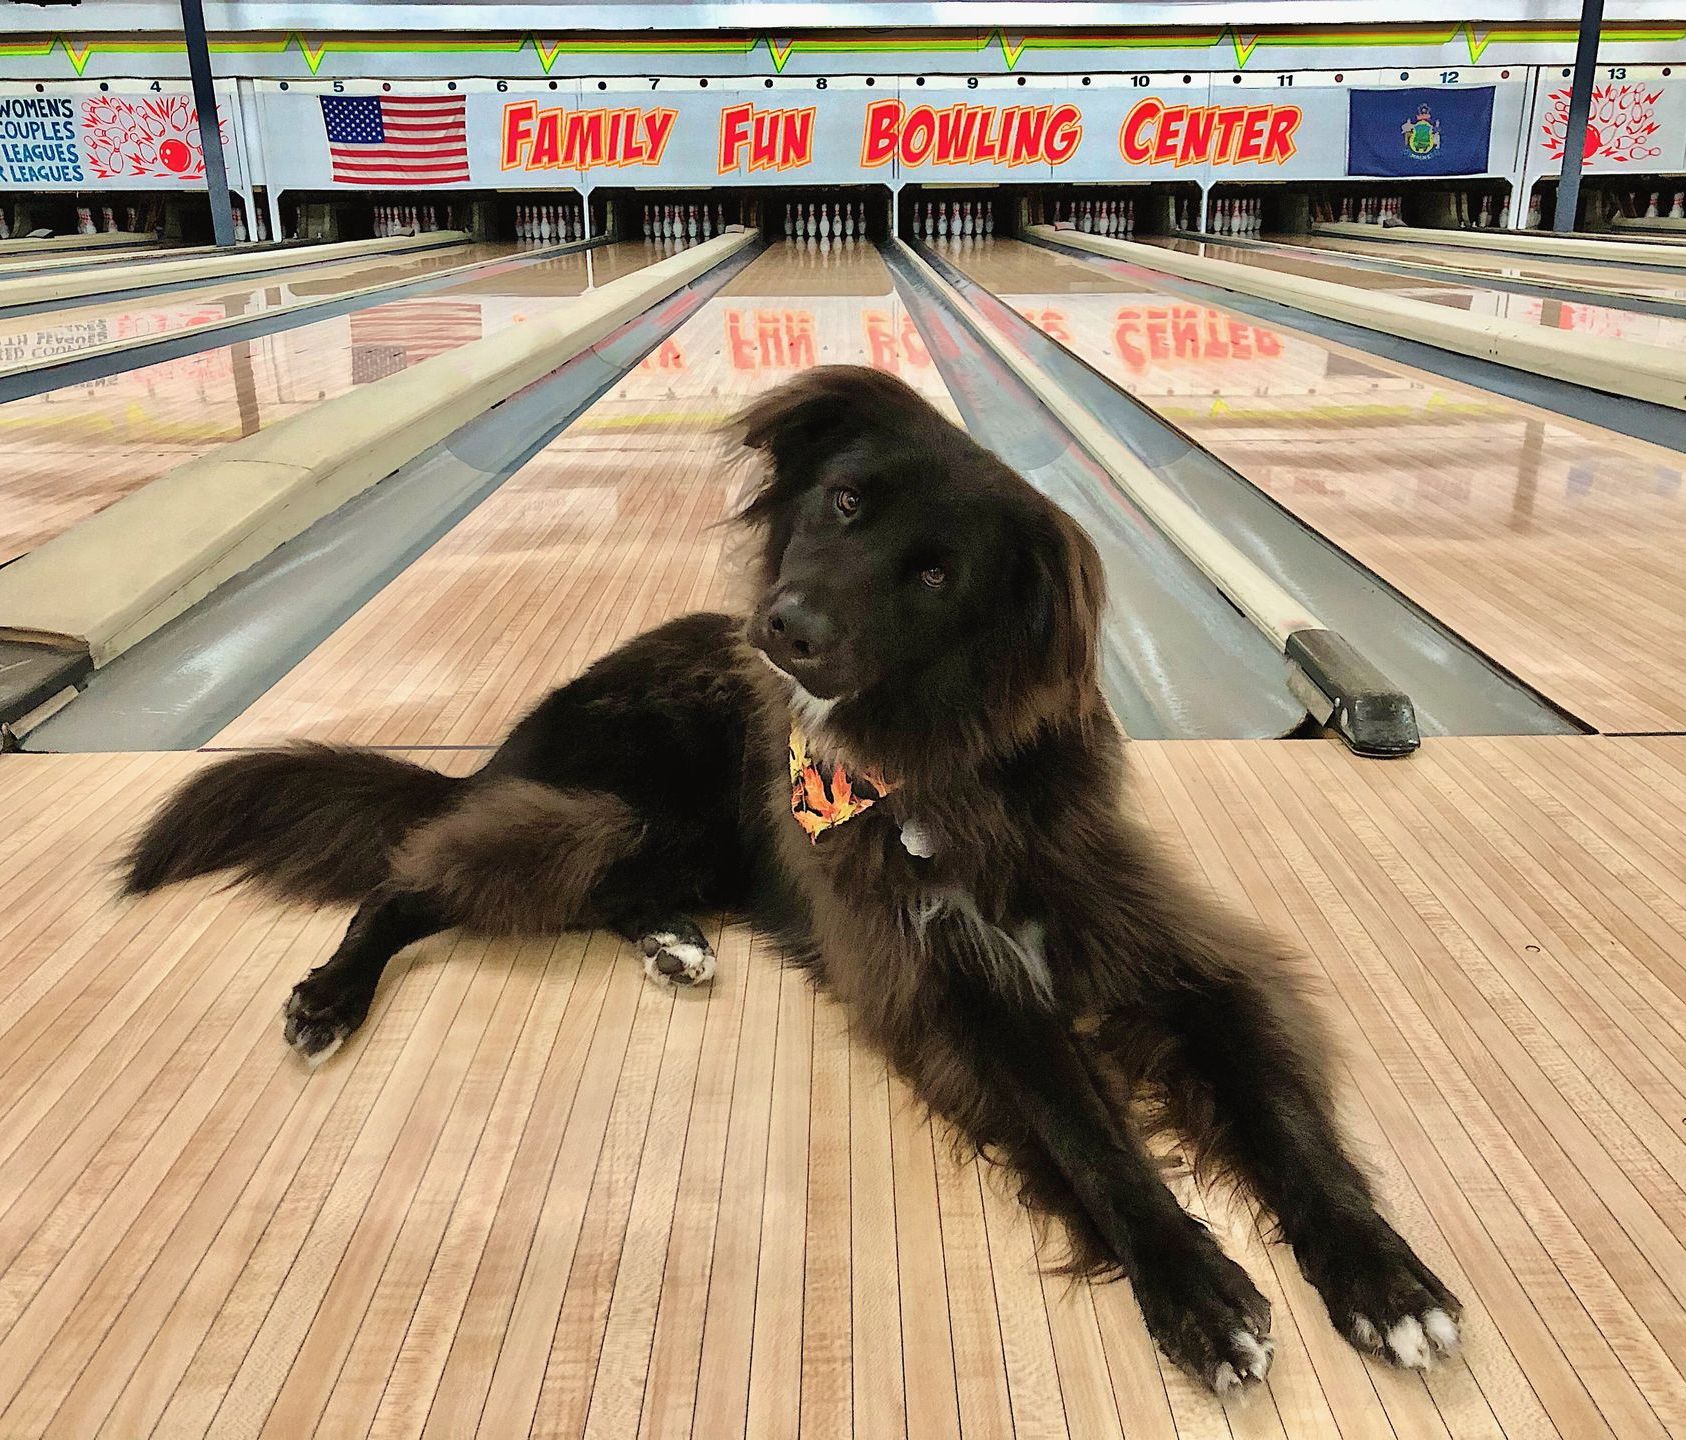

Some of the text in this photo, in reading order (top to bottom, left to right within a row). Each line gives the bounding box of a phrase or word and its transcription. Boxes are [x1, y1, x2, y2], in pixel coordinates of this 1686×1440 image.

[1439, 71, 1460, 84] 12
[1607, 67, 1627, 80] 13
[149, 80, 162, 93] 4
[333, 80, 345, 93] 5
[496, 80, 509, 93] 6
[648, 78, 661, 91] 7
[815, 77, 828, 90] 8
[967, 76, 979, 90] 9
[1130, 75, 1151, 88] 10
[1277, 74, 1294, 87] 11
[501, 96, 1302, 174] FAMILY FUN BOWLING CENTER
[2, 143, 79, 163] LEAGUES
[9, 164, 84, 182] LEAGUES
